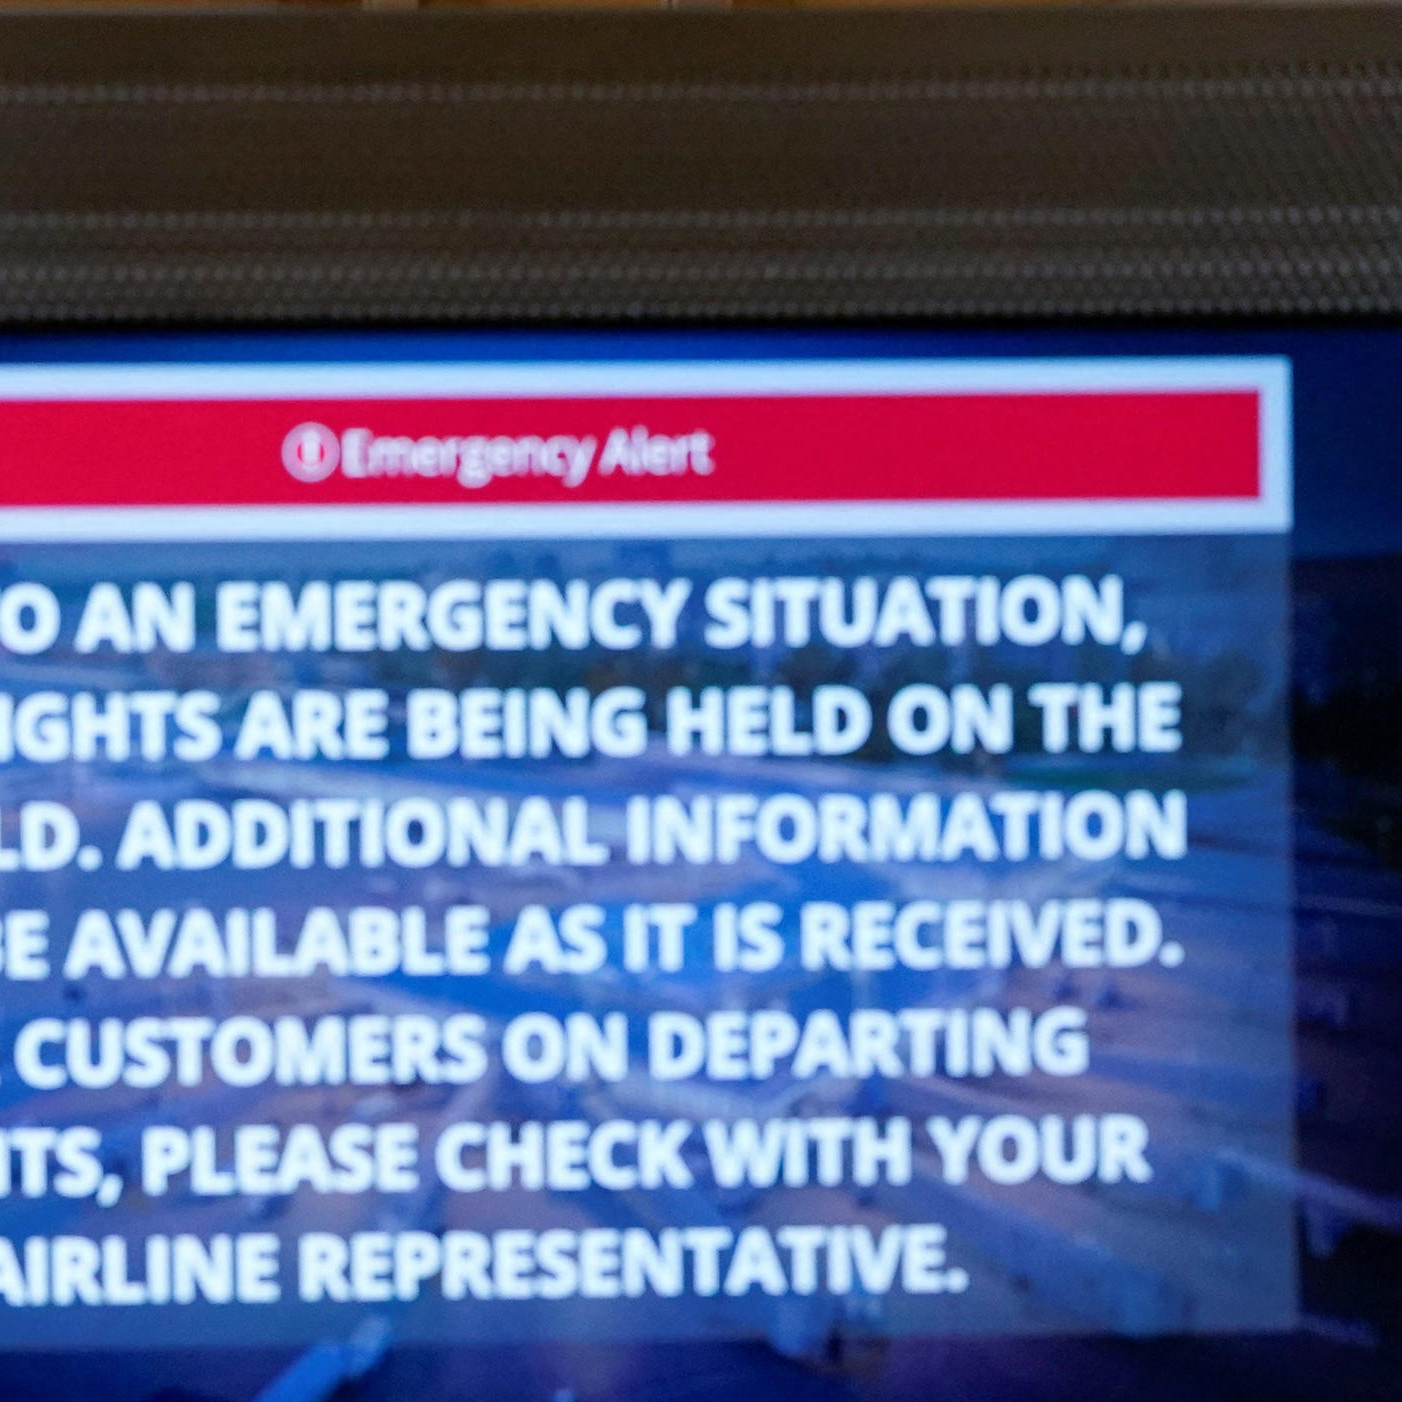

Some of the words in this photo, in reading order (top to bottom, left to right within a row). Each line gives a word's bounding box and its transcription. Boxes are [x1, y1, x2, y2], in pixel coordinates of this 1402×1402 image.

[341, 428, 596, 484] Emergency
[599, 427, 712, 475] Alert
[76, 585, 193, 651] AN
[219, 581, 687, 650] EMERGENCY
[708, 578, 1142, 648] SITUATION,
[237, 691, 385, 759] ARE
[408, 690, 645, 757] BEING
[669, 689, 868, 756] HELD
[891, 688, 1010, 751] ON
[1033, 685, 1177, 749] THE
[120, 798, 606, 867] ADDITIONAL
[627, 794, 1183, 863] INFORMATION
[67, 907, 487, 977] AVAILABLE
[507, 906, 604, 972] AS
[626, 905, 693, 969] IT
[716, 905, 780, 970] IS
[803, 901, 1180, 968] RECEIVED.
[17, 1015, 486, 1086] CUSTOMERS
[505, 1016, 626, 1080] ON
[651, 1008, 1086, 1080] DEPARTING
[144, 1124, 417, 1193] PLEASE
[436, 1122, 689, 1190] CHECK
[706, 1118, 909, 1185] WITH
[931, 1116, 1147, 1183] YOUR
[300, 1226, 965, 1299] REPRESENTATIVE.
